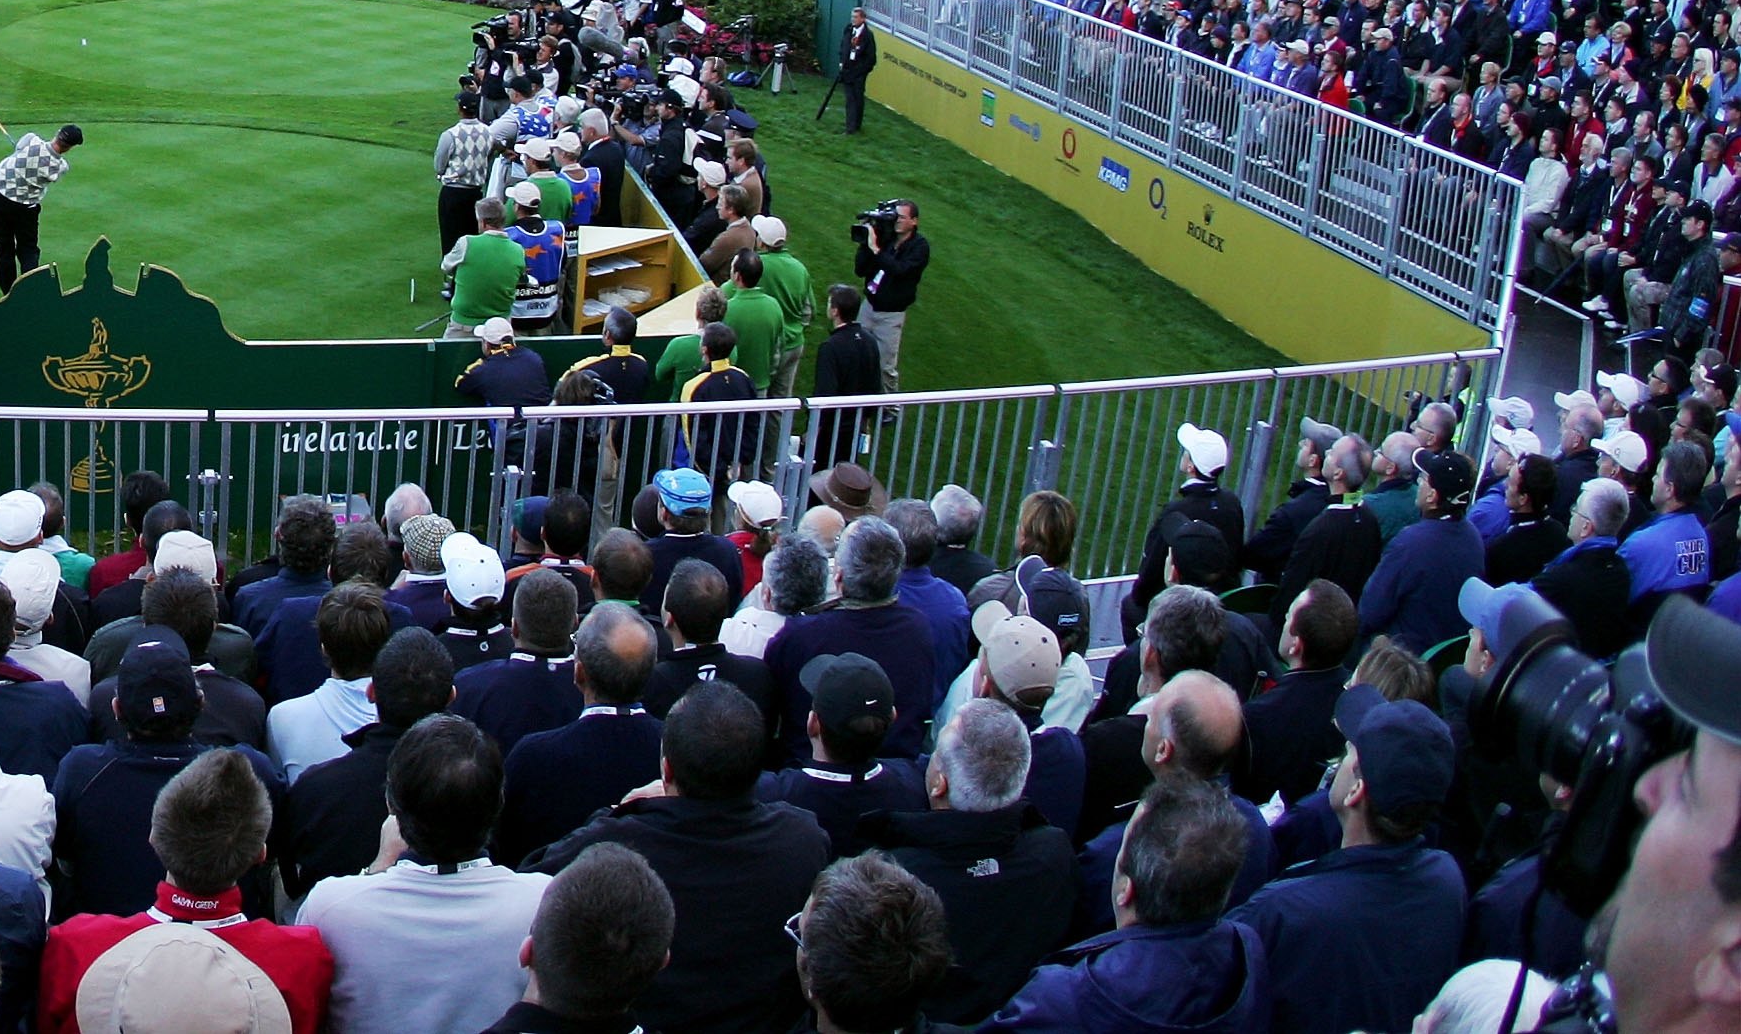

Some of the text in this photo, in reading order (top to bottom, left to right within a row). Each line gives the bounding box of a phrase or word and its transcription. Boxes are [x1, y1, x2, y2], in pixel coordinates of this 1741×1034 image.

[1098, 165, 1128, 193] KPMG
[1186, 220, 1225, 253] ROLEX
[281, 420, 418, 453] ireland.ie
